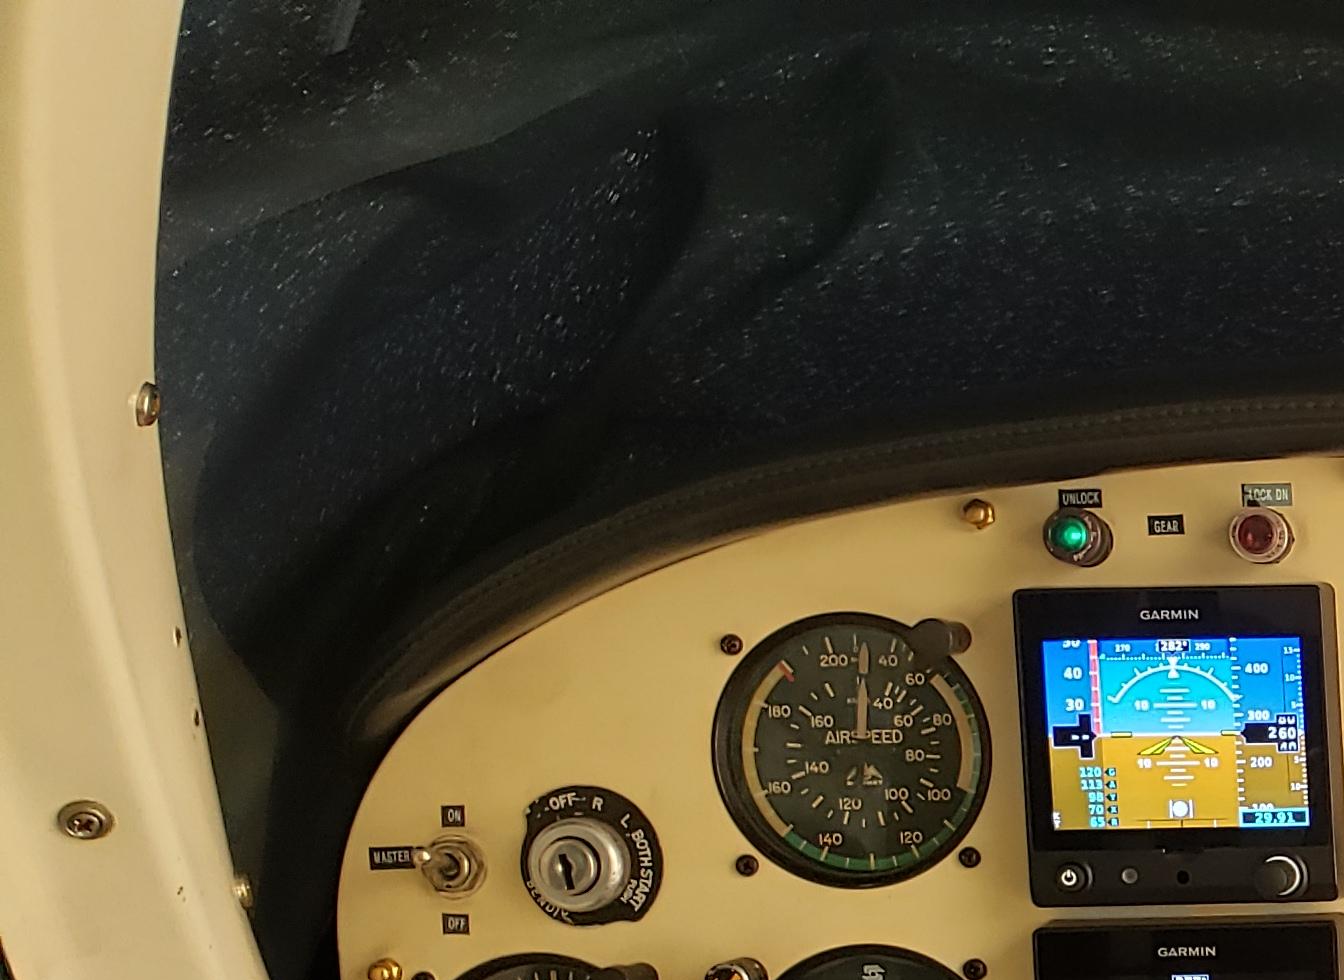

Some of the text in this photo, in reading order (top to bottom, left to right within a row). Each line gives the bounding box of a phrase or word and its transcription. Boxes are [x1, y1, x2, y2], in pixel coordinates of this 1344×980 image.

[1063, 492, 1099, 505] UNLOCK
[1249, 488, 1289, 501] LOCK DN
[1154, 519, 1179, 533] GEAR
[1140, 609, 1199, 620] GARMIN
[1268, 726, 1297, 740] 260
[549, 794, 577, 812] OFF
[446, 808, 461, 823] ON
[1254, 812, 1296, 823] 29.91
[373, 849, 412, 865] MASTER
[630, 864, 654, 912] START
[447, 917, 467, 932] OFF
[1158, 946, 1216, 957] GARMIN
